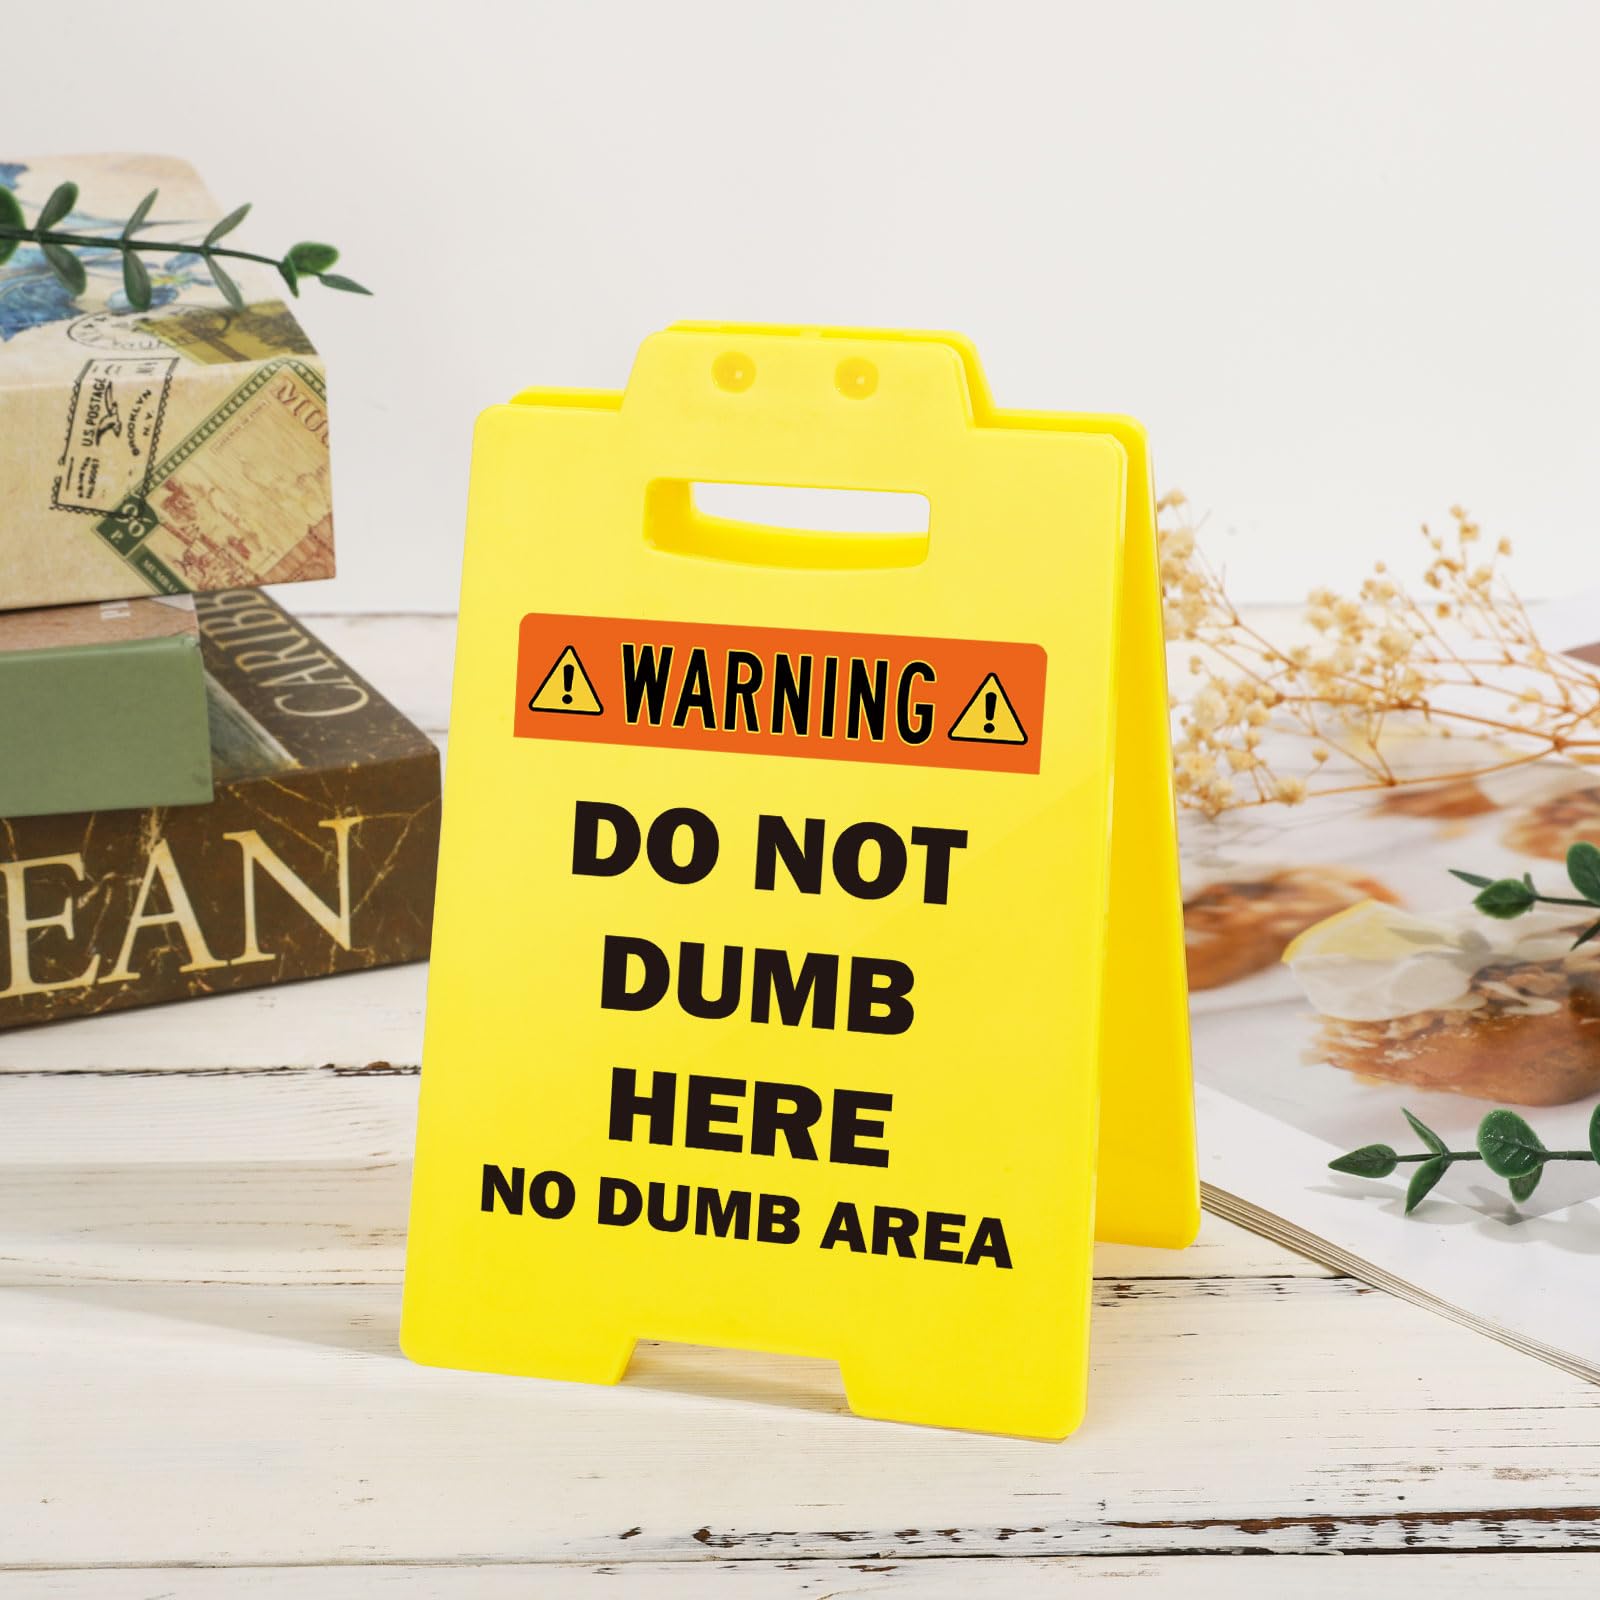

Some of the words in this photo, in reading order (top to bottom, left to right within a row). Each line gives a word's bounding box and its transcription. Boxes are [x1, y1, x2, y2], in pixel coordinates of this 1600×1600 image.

[621, 642, 938, 747] WARNING
[573, 801, 720, 885] DO
[755, 814, 968, 905] NOT
[602, 935, 915, 1035] DUMB
[609, 1067, 893, 1168] HERE
[481, 1164, 575, 1220] NO
[598, 1177, 800, 1245] DUMB
[820, 1202, 1013, 1269] AREA
